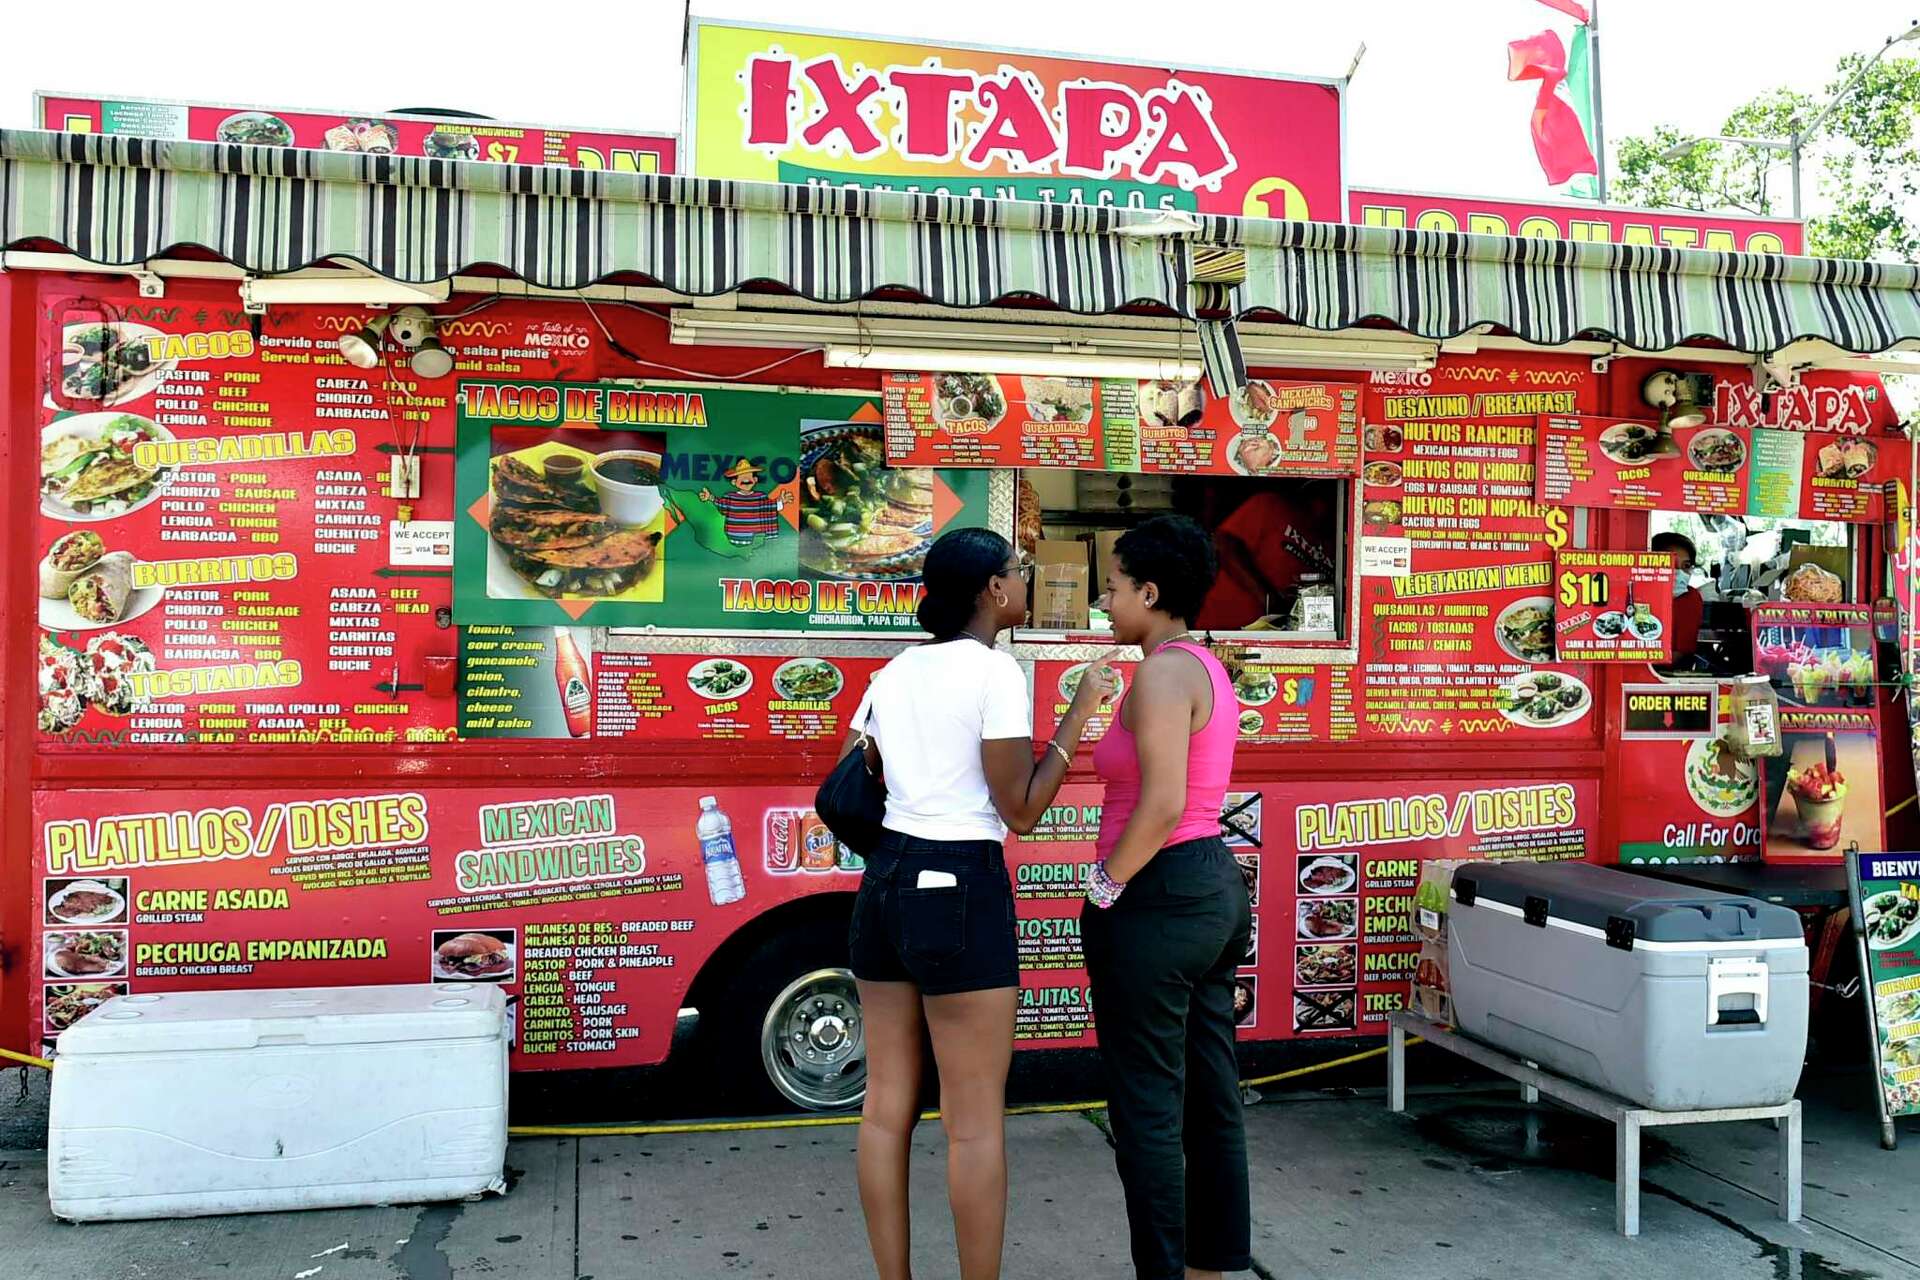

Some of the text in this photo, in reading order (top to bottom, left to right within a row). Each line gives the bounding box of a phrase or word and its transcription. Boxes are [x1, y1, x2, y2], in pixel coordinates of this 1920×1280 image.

[740, 48, 1238, 192] IXTAPA
[146, 330, 255, 363] TACOS
[259, 335, 313, 349] Servido
[463, 345, 498, 357] salsa
[501, 347, 550, 361] picante
[155, 370, 261, 384] PASTOR PORK
[316, 378, 369, 390] CABEZA
[155, 385, 249, 398] ASADA BEEF
[316, 393, 374, 404] CHORIZO
[1279, 386, 1325, 399] MEXICAN
[155, 400, 270, 413] POLLO CHICKEN
[461, 384, 708, 427] TACOS DE BIRRIA
[1270, 397, 1334, 410] SANDWICHES
[1386, 393, 1575, 418] DESAYUNO BREAKFAST
[1713, 382, 1873, 434] IXTAPA
[155, 414, 273, 427] LENGUA TONGUE
[316, 407, 389, 420] BARBACOA
[946, 418, 989, 434] TACOS
[1022, 422, 1090, 435] QUESADILLAS
[1140, 426, 1188, 440] BURRITOS
[1402, 422, 1461, 443] HUEVOS
[133, 430, 356, 469] QUESADILLAS
[659, 452, 798, 485] MEXCO
[1402, 461, 1535, 482] HUEVOS CON CHORIZO
[1616, 469, 1650, 482] TACOS
[1682, 470, 1736, 484] QUESADILLAS
[1811, 476, 1858, 489] BURRITOS
[315, 500, 366, 511] MIXTAS
[1402, 496, 1550, 518] HUEVOS CON NOPALES
[315, 514, 382, 526] CARNITAS
[1402, 517, 1480, 529] CACTUS WITH EGGS
[315, 529, 380, 540] CUERITOS
[394, 531, 452, 541] WE ACCEPT
[314, 543, 358, 554] BUCHE
[1365, 545, 1408, 554] WE ACCEPT
[1559, 553, 1672, 567] SPECIAL COMBO IXTAPA
[132, 554, 297, 589] BURRITOS
[1392, 562, 1553, 598] VEGETARIAN MENU
[719, 578, 812, 613] TACOS
[816, 581, 852, 614] DE
[1373, 604, 1489, 617] QUESADILLAS BURRITOS
[1757, 609, 1871, 625] MIX DE FRUTAS
[808, 614, 912, 627] CHICHARRON, PAPA CON
[1388, 621, 1474, 634] TACOS TOSTADAS
[467, 625, 515, 637] tomato,
[467, 641, 547, 652] sour cream,
[1390, 639, 1473, 651] TORTAS CEMITAS
[466, 656, 538, 669] guacamole,
[128, 661, 302, 699] TOSTADAS
[467, 672, 505, 684] onion,
[466, 685, 522, 698] cilantro,
[466, 703, 513, 713] cheese
[703, 702, 739, 716] TACOS
[767, 700, 832, 712] QUESADILLAS
[1629, 696, 1707, 711] ORDER HERE
[466, 717, 532, 729] mild salsa
[481, 796, 616, 845] MEXICAN
[1297, 796, 1449, 850] PLATILLOS
[1472, 783, 1575, 834] DISHES
[45, 795, 429, 873] PLATILLOS DISHES
[1663, 824, 1695, 847] Call
[1699, 824, 1729, 847] For
[456, 836, 645, 891] SANDWICHES
[1365, 860, 1418, 878] CARNE
[1016, 864, 1074, 883] ORDEN
[1364, 879, 1415, 888] GRILLED STEAK
[135, 888, 290, 912] CARNE ASADA
[135, 912, 204, 924] GRILLED STEAK
[524, 920, 696, 935] MILANESA DE RES BREADED BEEF
[524, 933, 628, 947] MILANESA DE POLLO
[135, 938, 388, 965] PECHUGA EMPANIZADA
[524, 944, 659, 959] BREADED CHICKEN BREAST
[135, 963, 254, 977] BREADED CHICKEN BREAST
[524, 956, 675, 971] PASTOR PORK PINEAPPLE
[524, 970, 593, 983] ASADA BEEF
[524, 982, 616, 995] LENGUA TONGUE
[524, 994, 601, 1006] CABEZA HEAD
[1363, 993, 1403, 1011] TRES
[523, 1005, 627, 1018] CHORIZO SAUSAGE
[523, 1017, 612, 1030] CARNITAS PORK
[523, 1027, 639, 1042] CUERITOS PORK SKIN
[523, 1040, 616, 1054] BUCHE STOMACH
